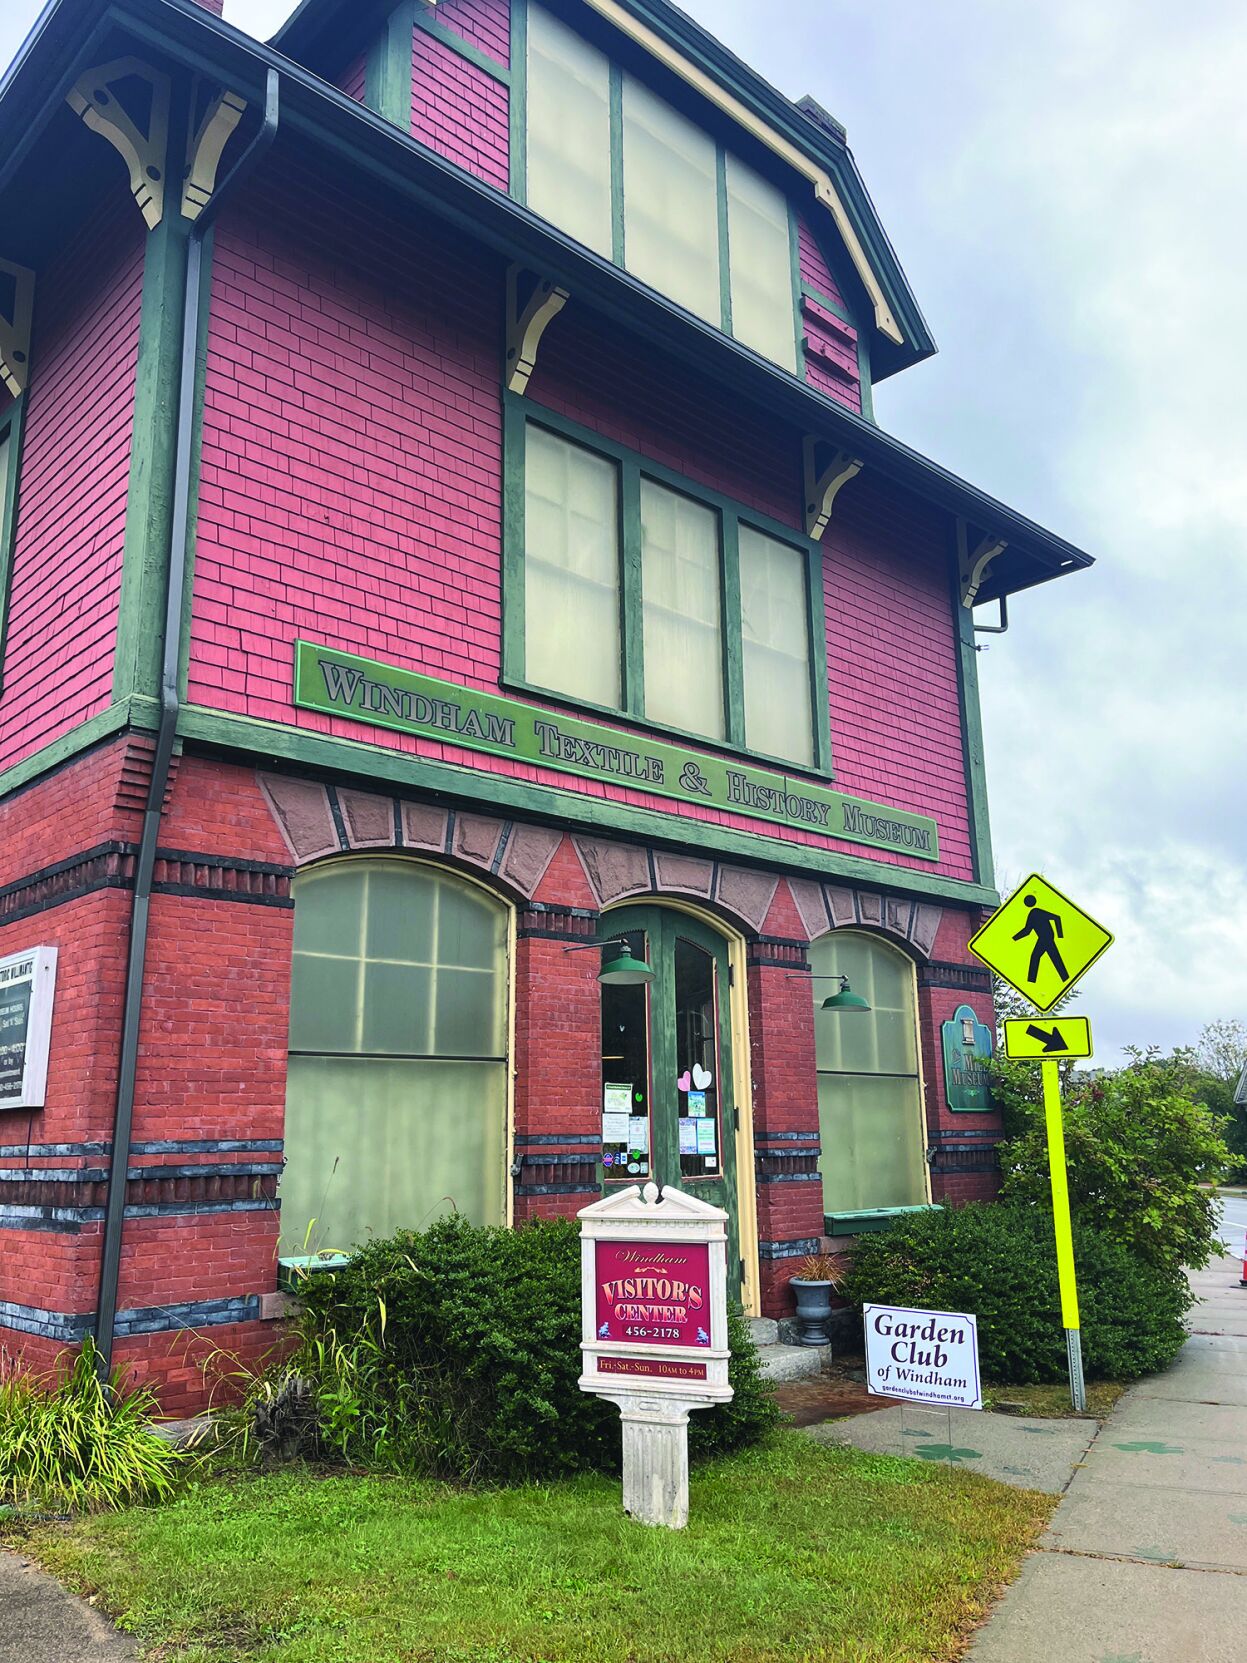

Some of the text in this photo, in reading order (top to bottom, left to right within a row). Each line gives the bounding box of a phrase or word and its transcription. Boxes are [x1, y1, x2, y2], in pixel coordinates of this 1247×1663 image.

[318, 660, 931, 851] WINDHAM TEXTILE & HISTORY MUSEUM
[615, 1249, 688, 1264] Windham
[602, 1277, 703, 1310] VISITOR'S
[614, 1303, 688, 1323] CENTER
[625, 1326, 680, 1338] 456-2178
[874, 1314, 965, 1344] Garden
[890, 1341, 948, 1368] Club
[877, 1365, 967, 1388] of Windham
[882, 1385, 965, 1402] gardenclubofwindhamct.org
